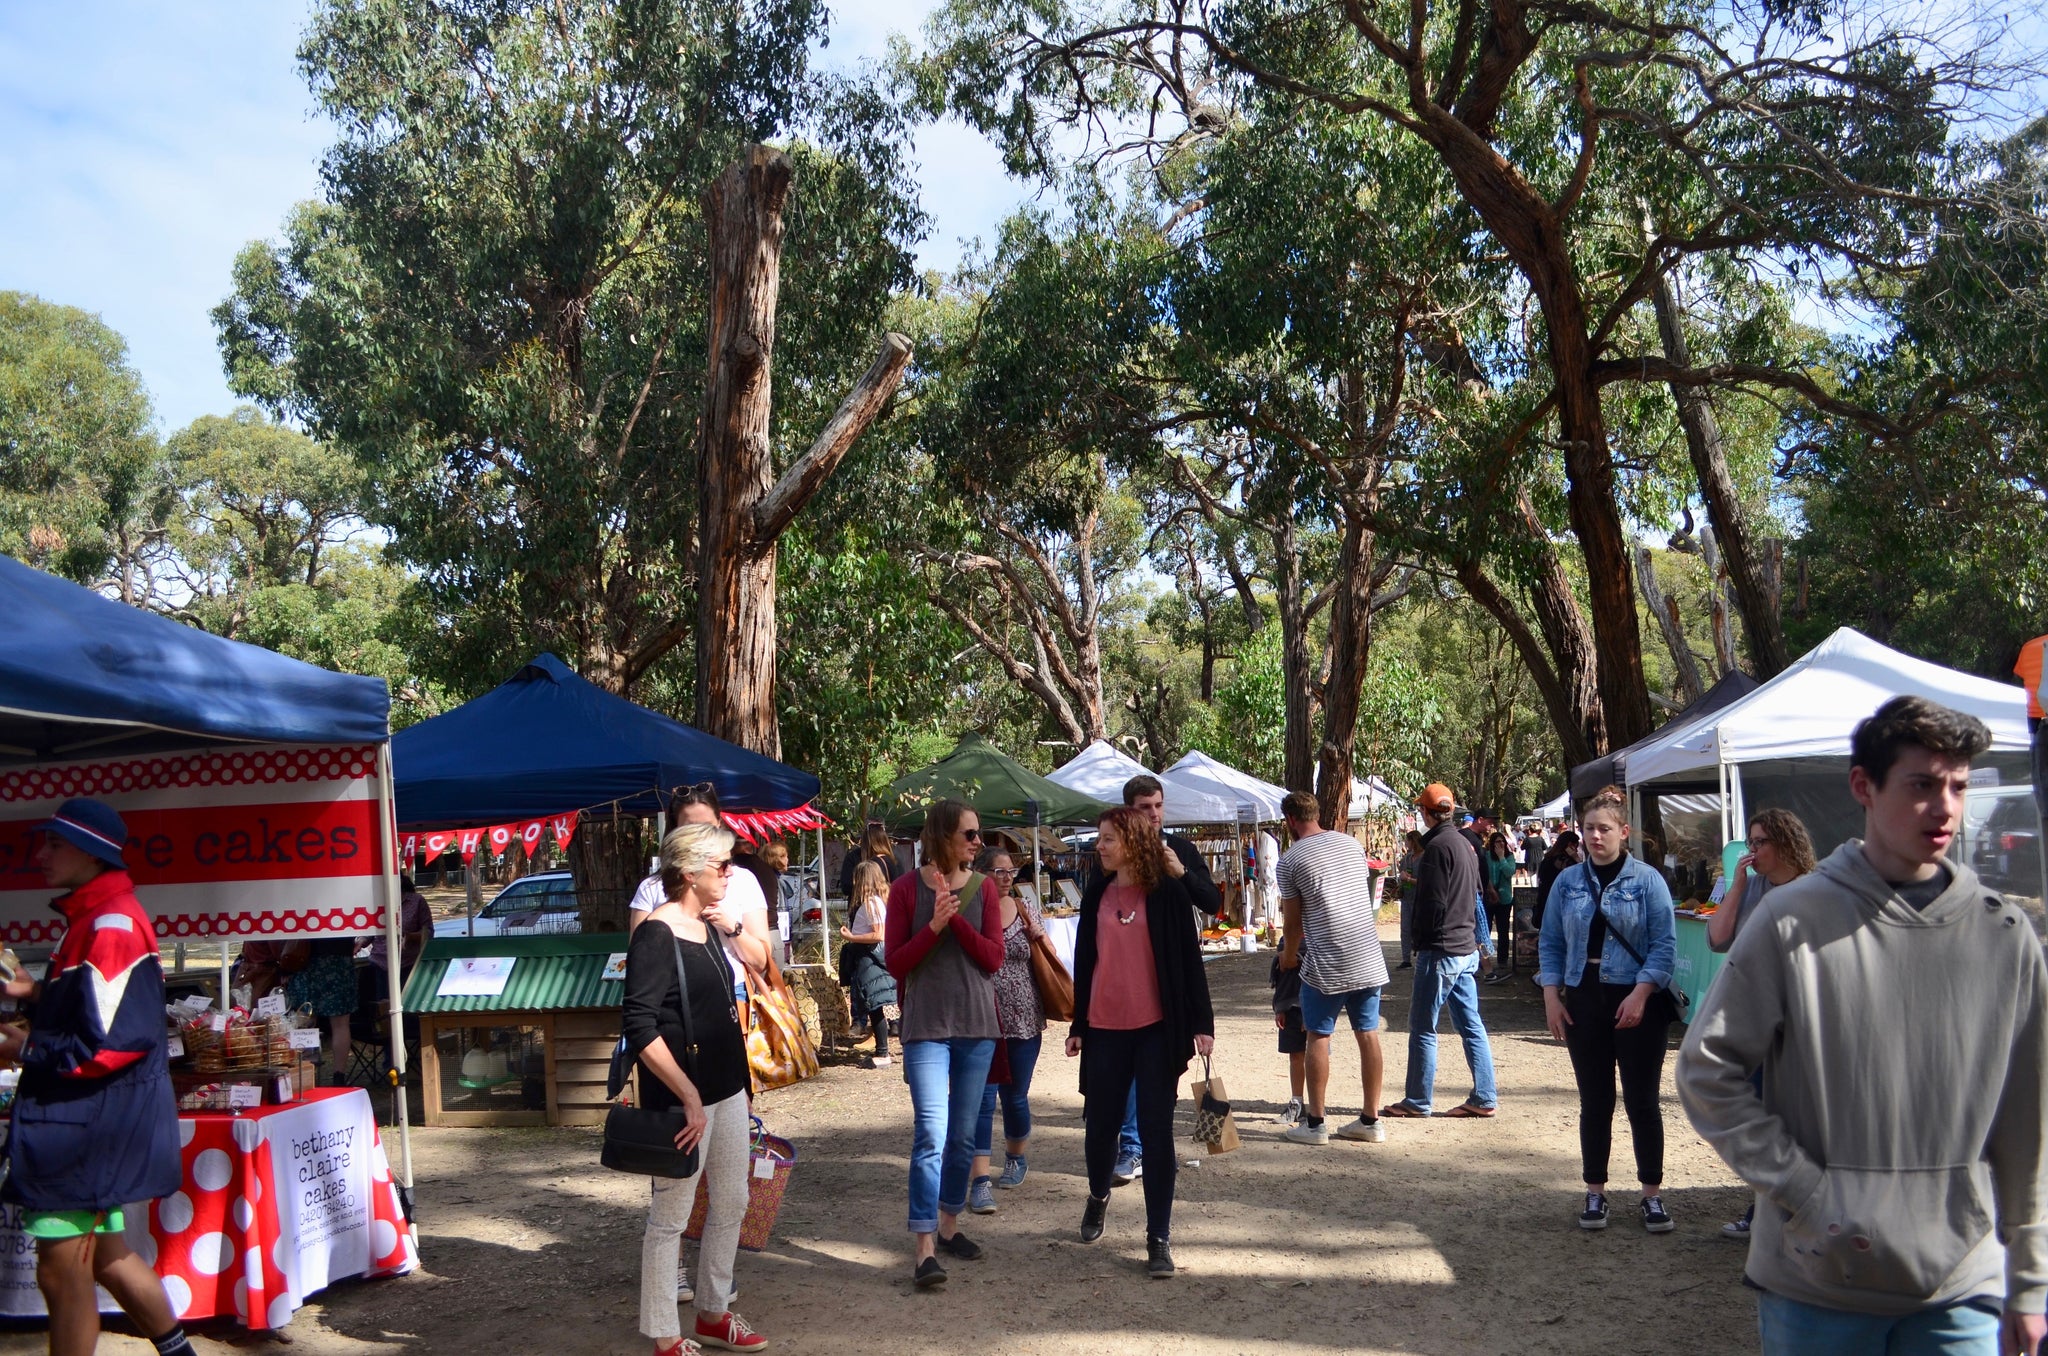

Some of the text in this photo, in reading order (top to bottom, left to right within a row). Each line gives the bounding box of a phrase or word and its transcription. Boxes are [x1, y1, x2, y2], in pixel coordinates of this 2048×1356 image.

[194, 817, 359, 866] cakes
[292, 1126, 355, 1160] bethany
[299, 1152, 351, 1183] claire
[304, 1178, 347, 1207] cakes
